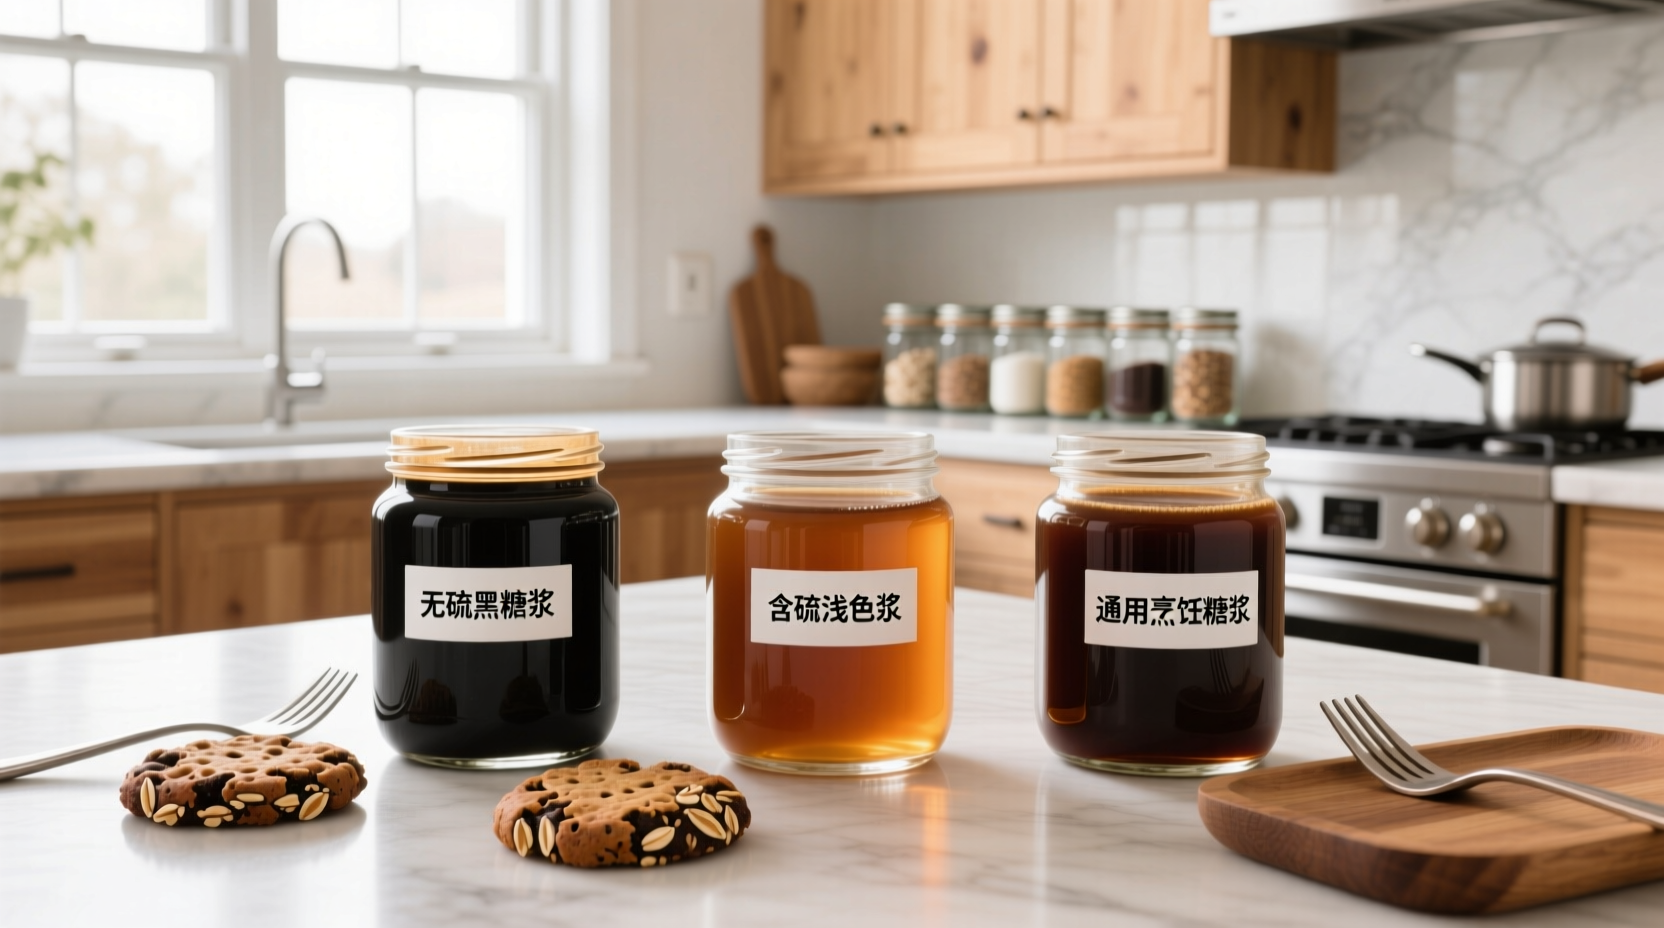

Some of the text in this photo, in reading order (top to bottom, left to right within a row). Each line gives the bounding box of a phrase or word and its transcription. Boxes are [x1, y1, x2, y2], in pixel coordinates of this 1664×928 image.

[420, 588, 555, 621] 无硫黑糖浆
[768, 592, 902, 624] 含硫浅色浆
[1095, 594, 1251, 627] 通用烹饪糖浆
